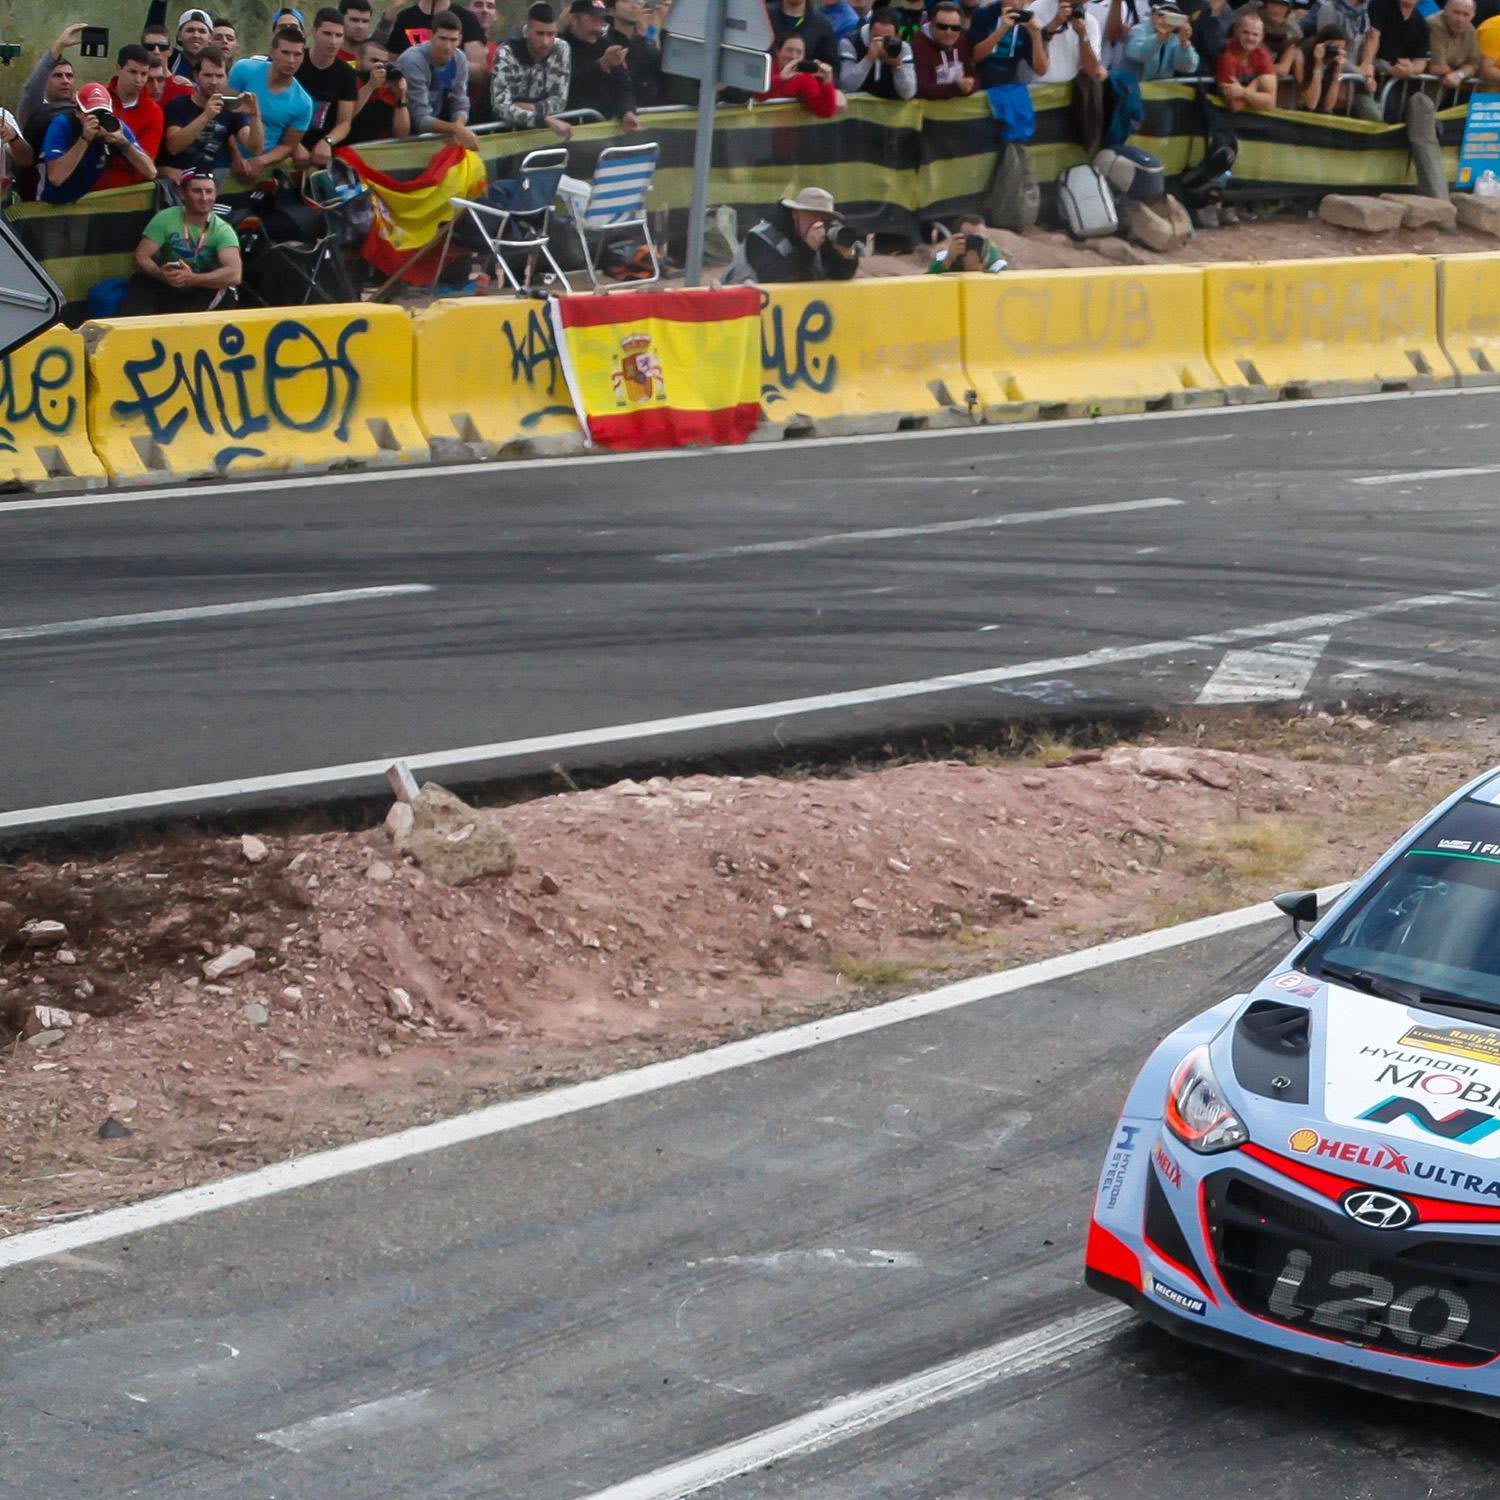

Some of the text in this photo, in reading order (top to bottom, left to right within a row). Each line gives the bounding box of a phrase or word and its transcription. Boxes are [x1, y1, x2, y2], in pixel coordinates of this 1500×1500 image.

[994, 280, 1156, 358] CLUB
[1221, 274, 1432, 349] SUBARU
[1359, 1045, 1481, 1077] HYUNDAI
[1101, 1152, 1122, 1193] STEEL
[1154, 1147, 1183, 1191] HELIX
[1316, 1138, 1412, 1176] HELIX
[1106, 1152, 1132, 1211] HYUNDAI
[1153, 1281, 1205, 1312] MICHELIN
